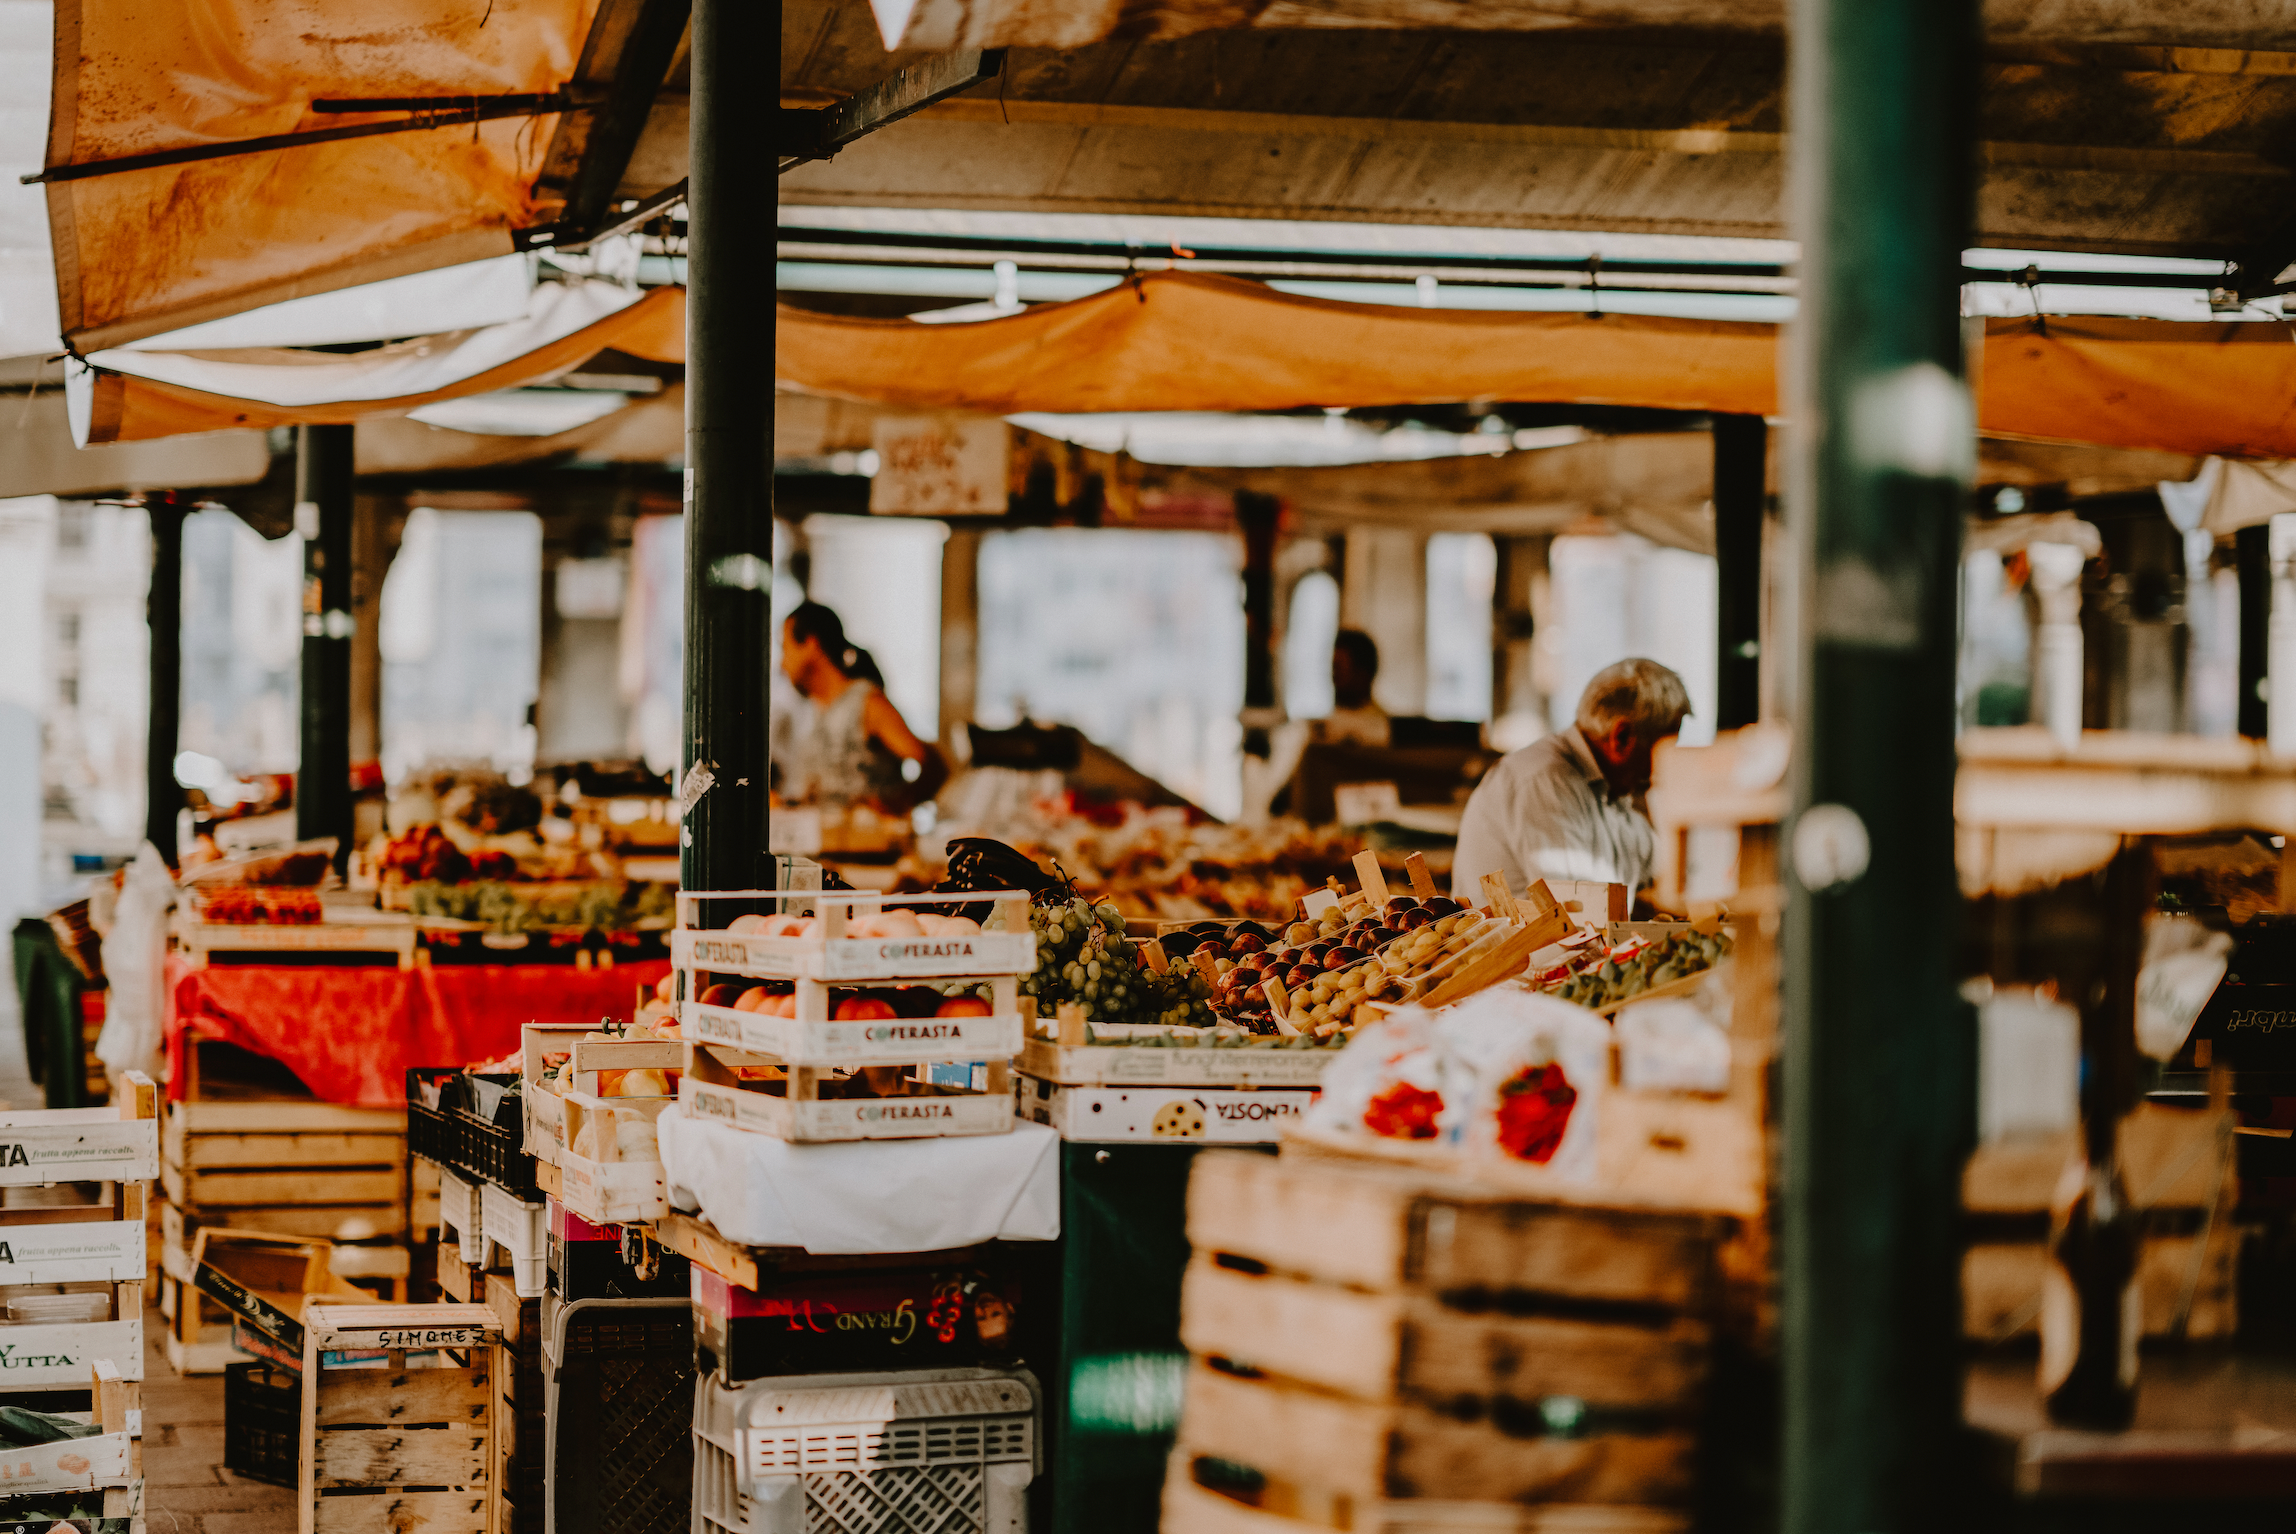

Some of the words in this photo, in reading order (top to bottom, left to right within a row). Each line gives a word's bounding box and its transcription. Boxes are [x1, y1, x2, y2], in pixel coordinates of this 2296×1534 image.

[879, 942, 973, 959] COFERASTA
[865, 1024, 961, 1041] COFERASTA
[856, 1103, 953, 1121] COFERASTA
[32, 1149, 59, 1160] frutta
[62, 1147, 95, 1158] appena
[18, 1246, 45, 1258] frutta
[47, 1245, 81, 1256] appena
[836, 1298, 917, 1345] GRAND
